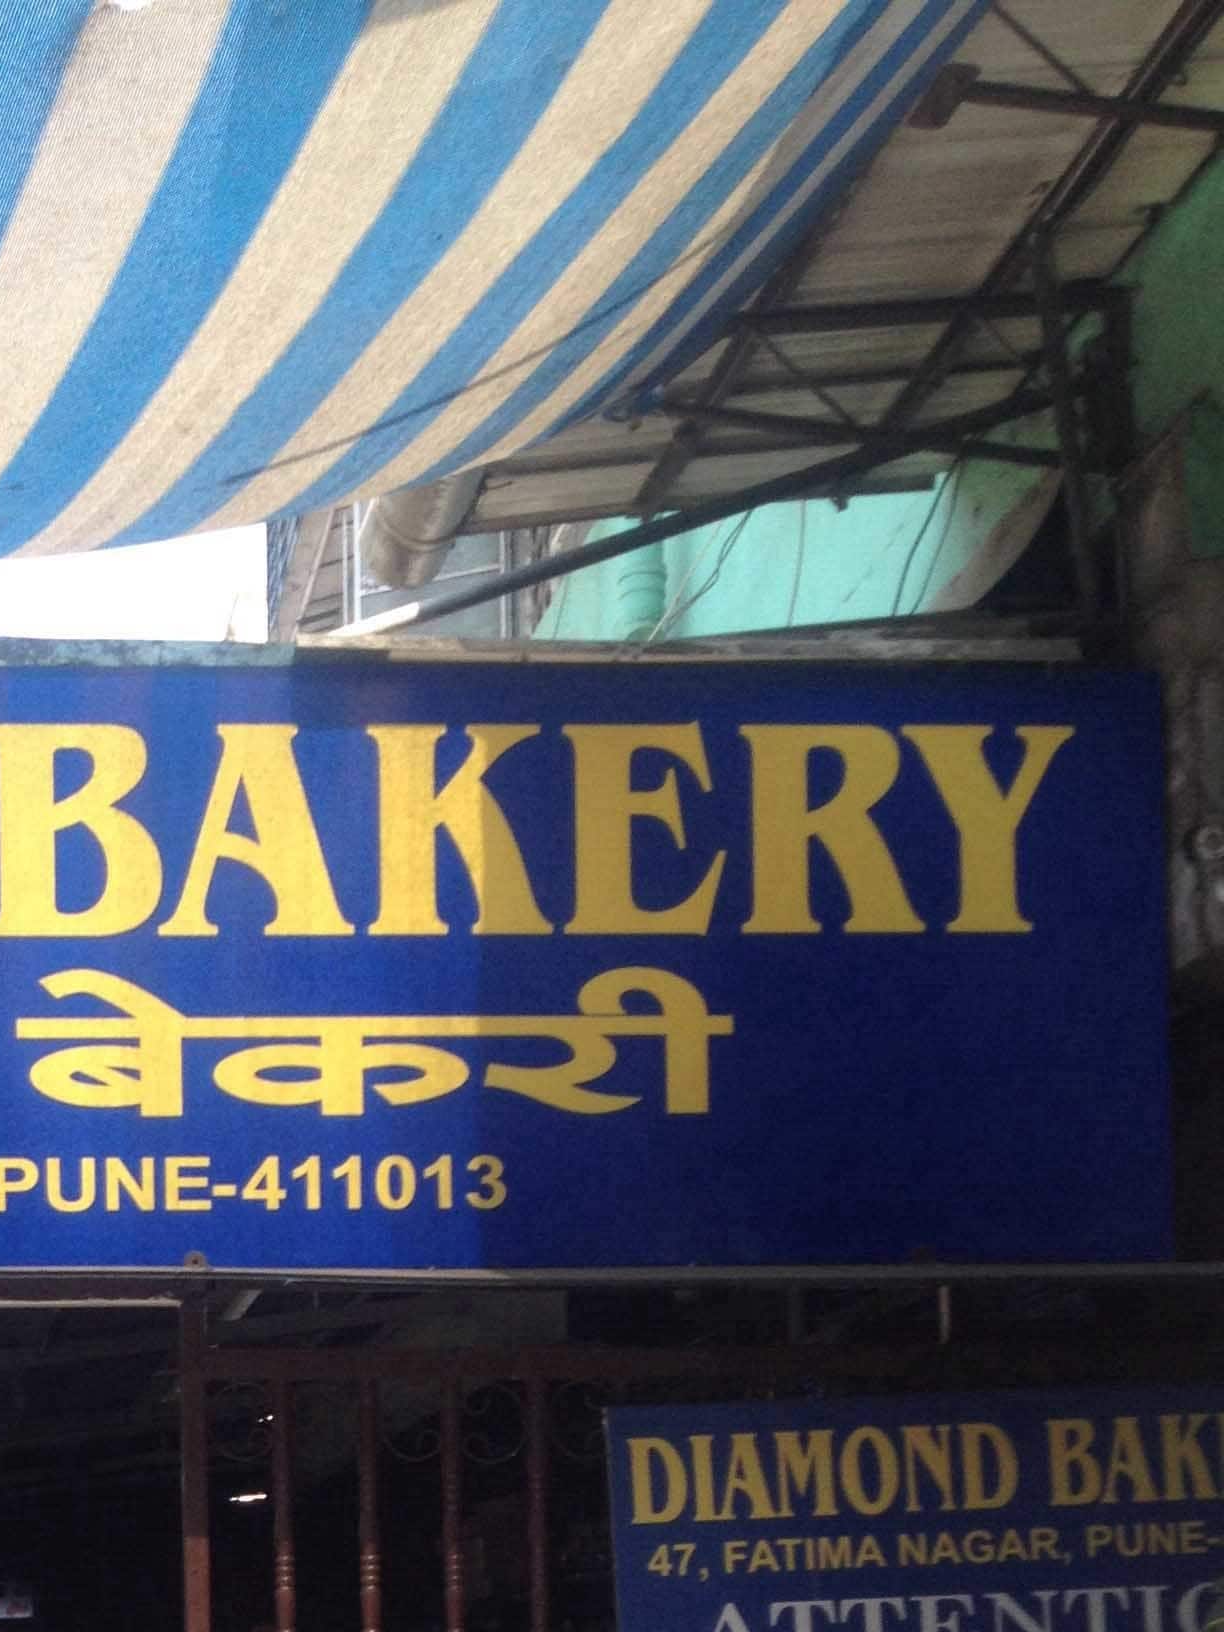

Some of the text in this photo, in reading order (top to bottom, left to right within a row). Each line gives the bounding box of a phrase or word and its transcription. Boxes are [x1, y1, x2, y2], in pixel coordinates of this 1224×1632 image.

[16, 966, 734, 1117] बेकरी
[626, 1413, 1224, 1525] DIAMOND BAK
[648, 1543, 708, 1582] 47,
[722, 1536, 885, 1574] FATIMA
[897, 1527, 1072, 1566] NAGAR,
